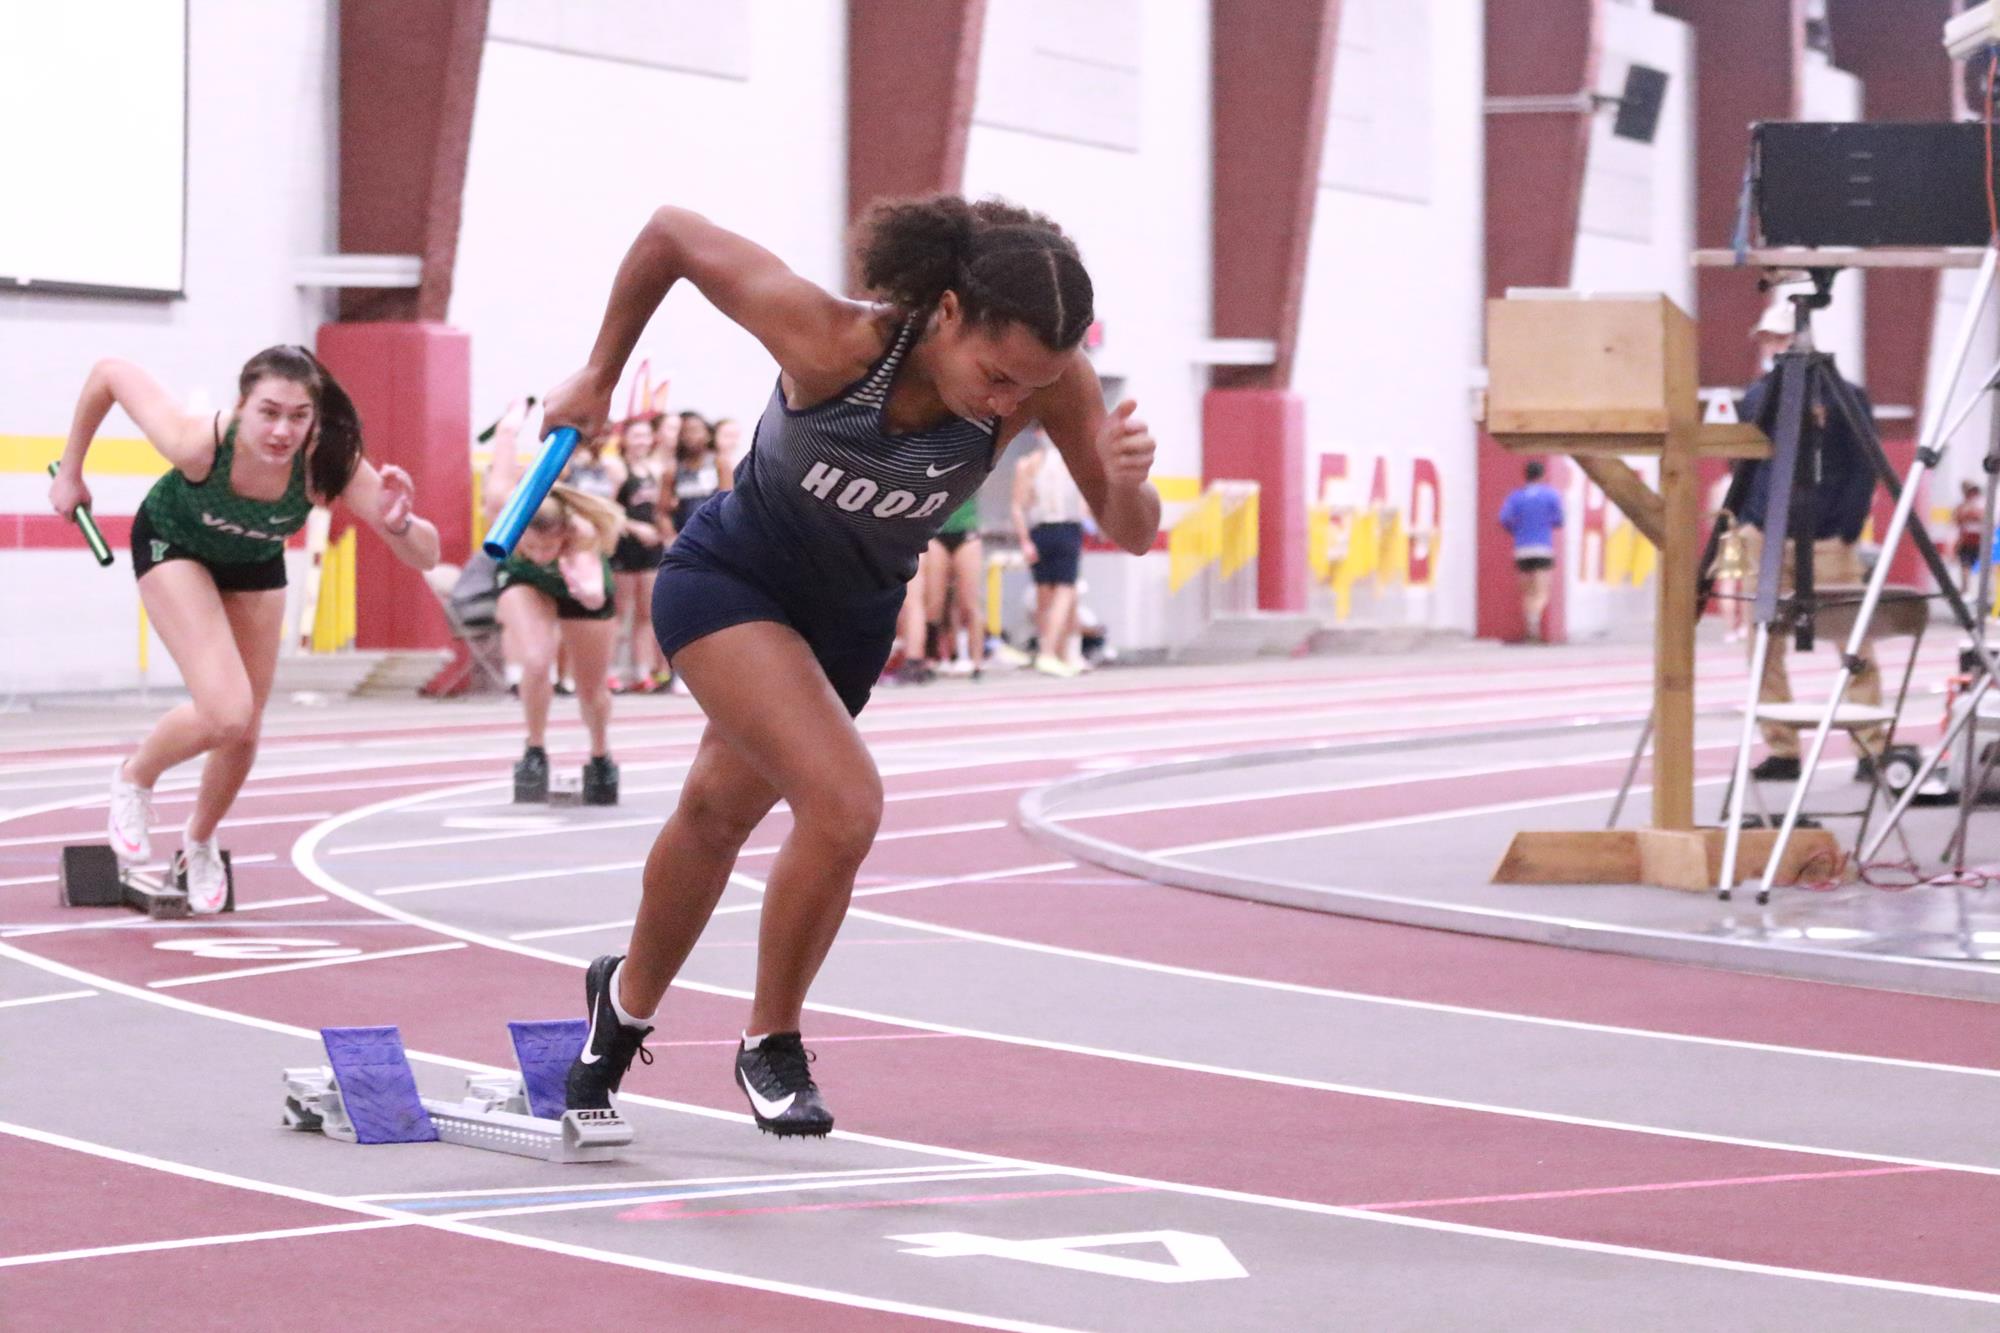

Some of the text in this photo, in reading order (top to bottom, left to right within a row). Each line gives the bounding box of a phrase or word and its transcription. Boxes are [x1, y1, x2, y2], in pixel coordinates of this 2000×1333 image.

[801, 461, 949, 518] HOOD
[150, 539, 170, 562] Y
[577, 1110, 620, 1120] GILL
[883, 1230, 1251, 1284] 4
